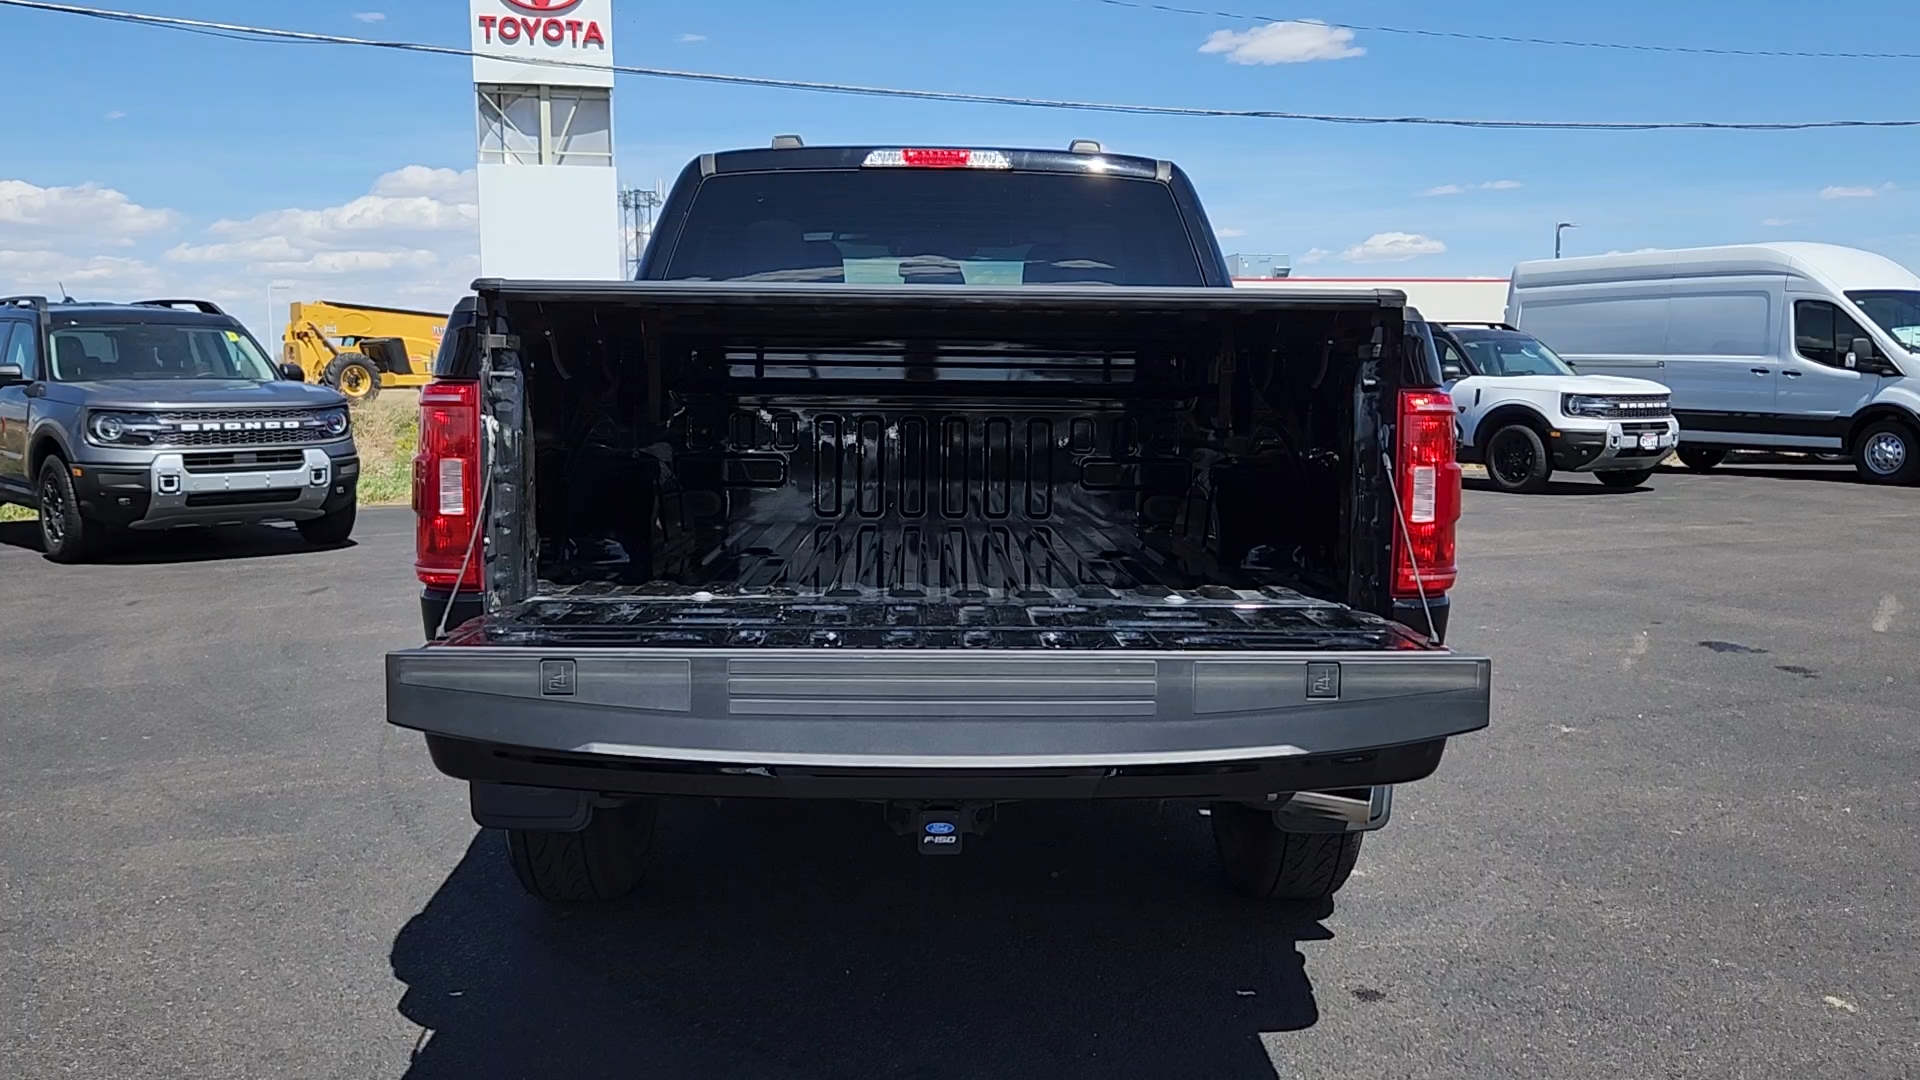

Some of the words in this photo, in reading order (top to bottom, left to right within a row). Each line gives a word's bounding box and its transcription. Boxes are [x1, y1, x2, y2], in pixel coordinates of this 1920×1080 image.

[479, 15, 604, 48] TOYOTA
[180, 421, 300, 431] BRONCO
[923, 835, 957, 844] F-150
